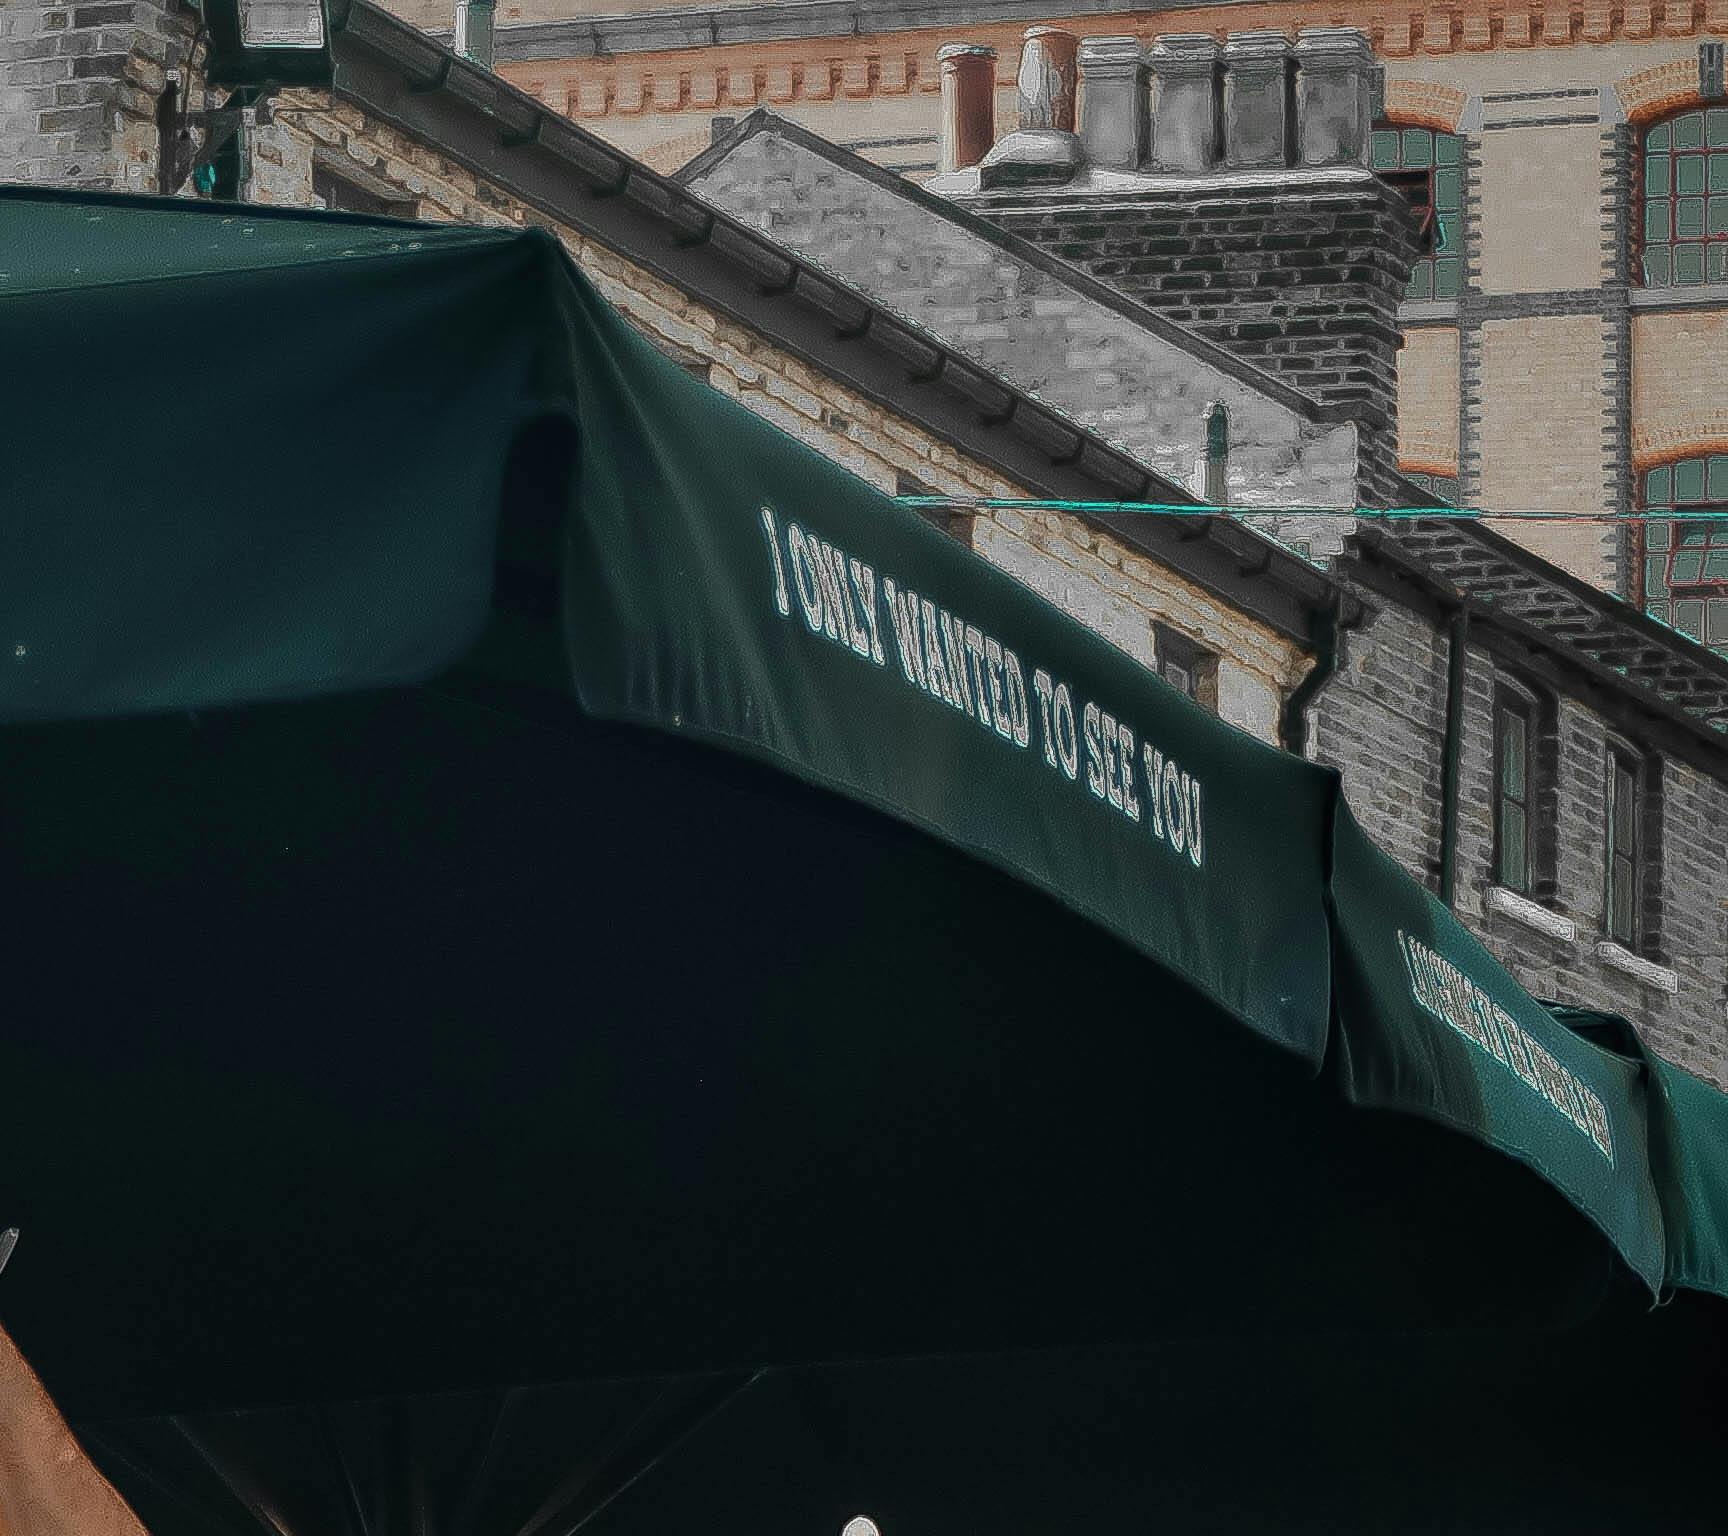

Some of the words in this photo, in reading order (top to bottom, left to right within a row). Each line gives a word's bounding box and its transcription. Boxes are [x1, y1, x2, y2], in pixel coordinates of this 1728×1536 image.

[760, 506, 790, 617] I
[787, 522, 886, 668] ONLY
[883, 576, 1030, 749] WANTED
[1033, 667, 1079, 781] TO
[1083, 701, 1141, 824] SEE
[1142, 742, 1203, 869] YOU
